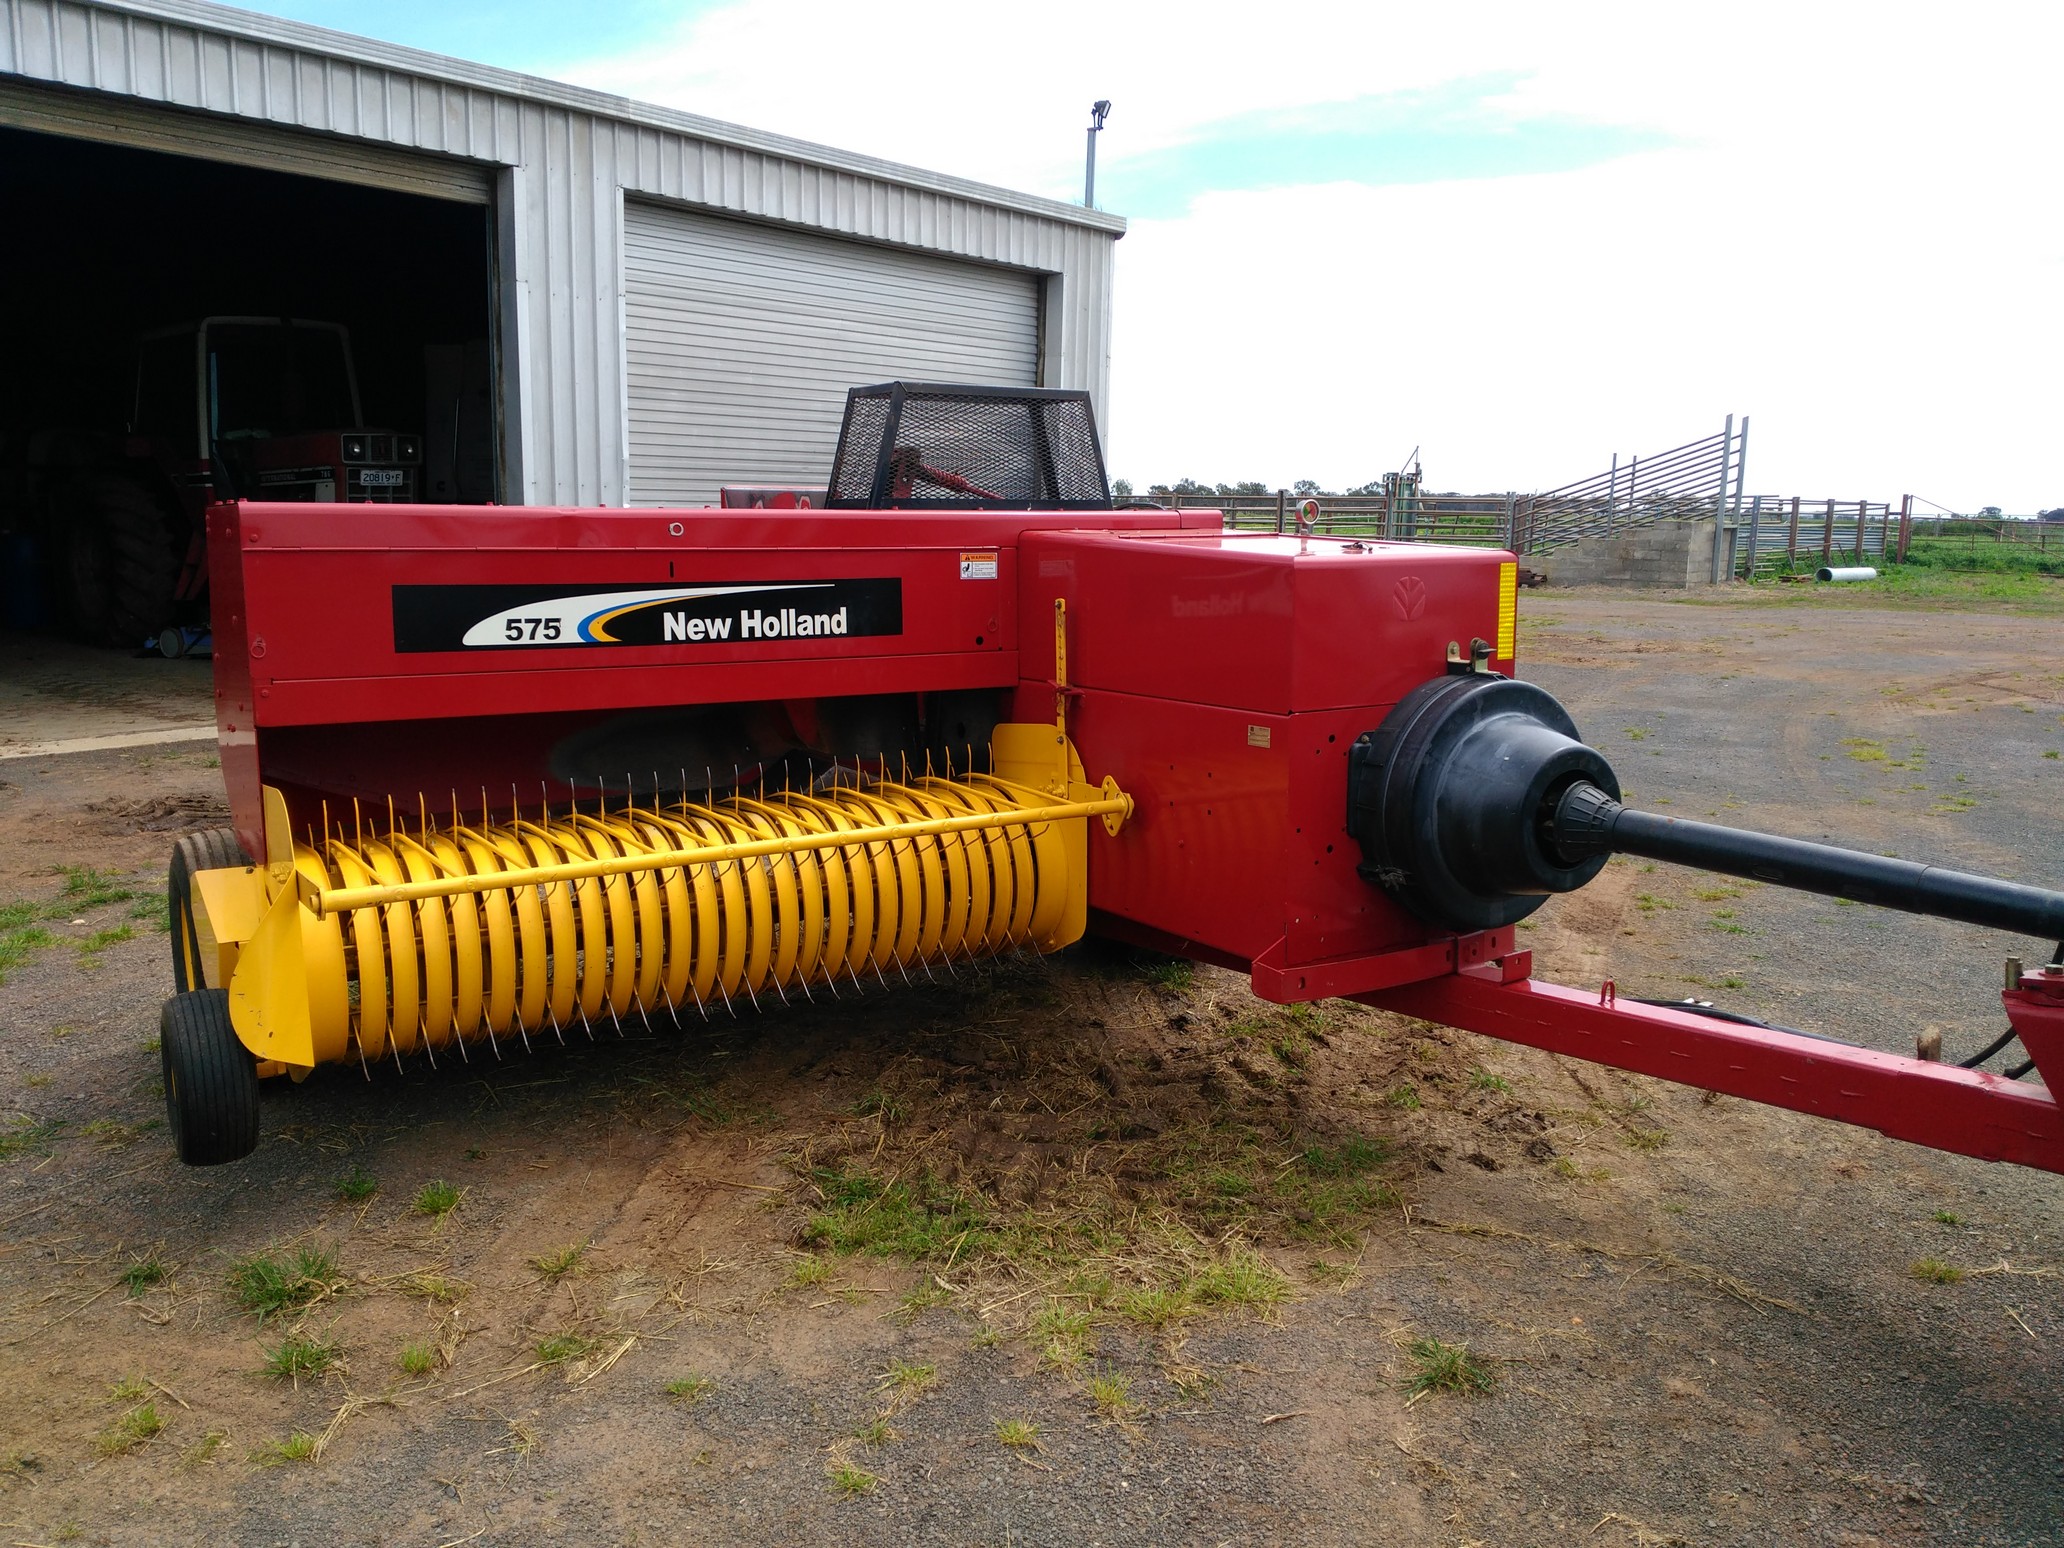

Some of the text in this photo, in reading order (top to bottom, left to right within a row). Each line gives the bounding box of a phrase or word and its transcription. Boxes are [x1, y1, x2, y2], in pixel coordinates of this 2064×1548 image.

[504, 617, 562, 642] 575
[663, 606, 848, 642] New Holland
